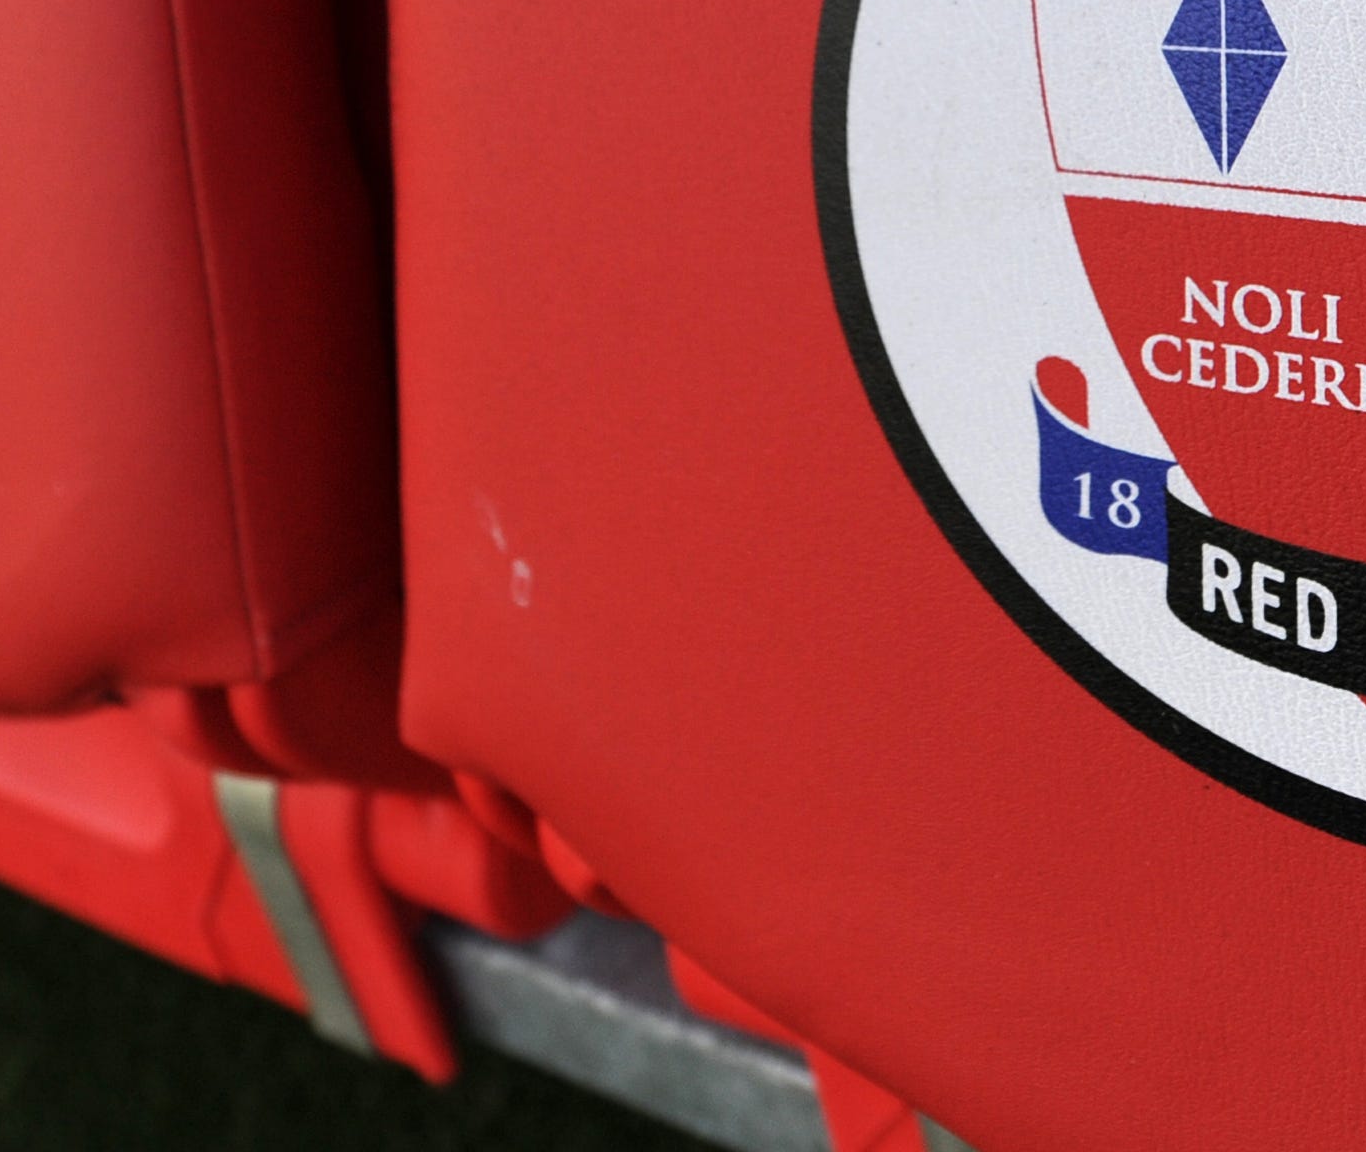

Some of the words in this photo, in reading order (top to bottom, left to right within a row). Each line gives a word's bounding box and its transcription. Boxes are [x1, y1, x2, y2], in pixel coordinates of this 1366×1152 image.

[1181, 275, 1343, 345] NOLI
[1072, 471, 1143, 528] 18
[1201, 542, 1338, 653] RED
